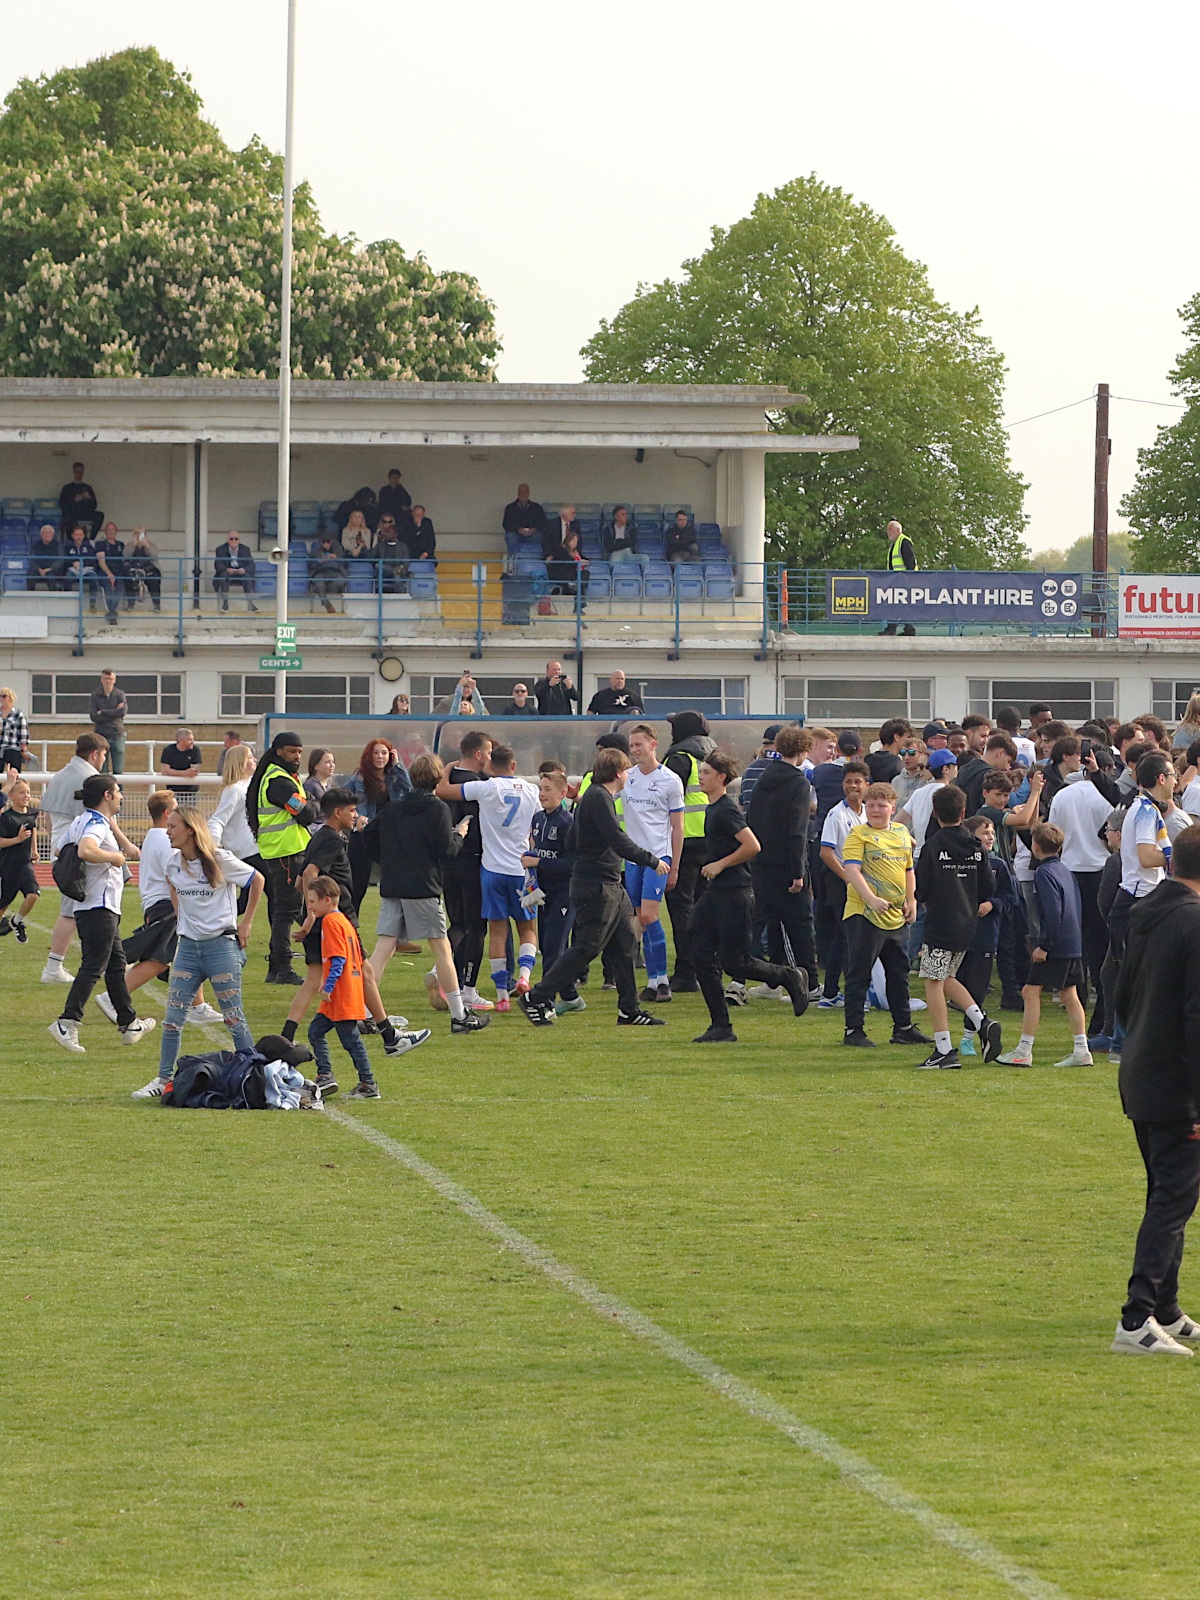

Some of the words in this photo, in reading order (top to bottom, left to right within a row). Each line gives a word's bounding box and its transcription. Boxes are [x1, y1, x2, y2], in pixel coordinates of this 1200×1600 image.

[835, 597, 865, 607] MPH
[876, 588, 908, 605] MR
[911, 588, 982, 605] PLANT
[984, 589, 1034, 606] HIRE
[277, 626, 296, 638] EXIT
[261, 659, 292, 667] GENTS
[628, 796, 659, 808] Powerday
[502, 796, 521, 827] 7
[177, 888, 215, 897] Powerday
